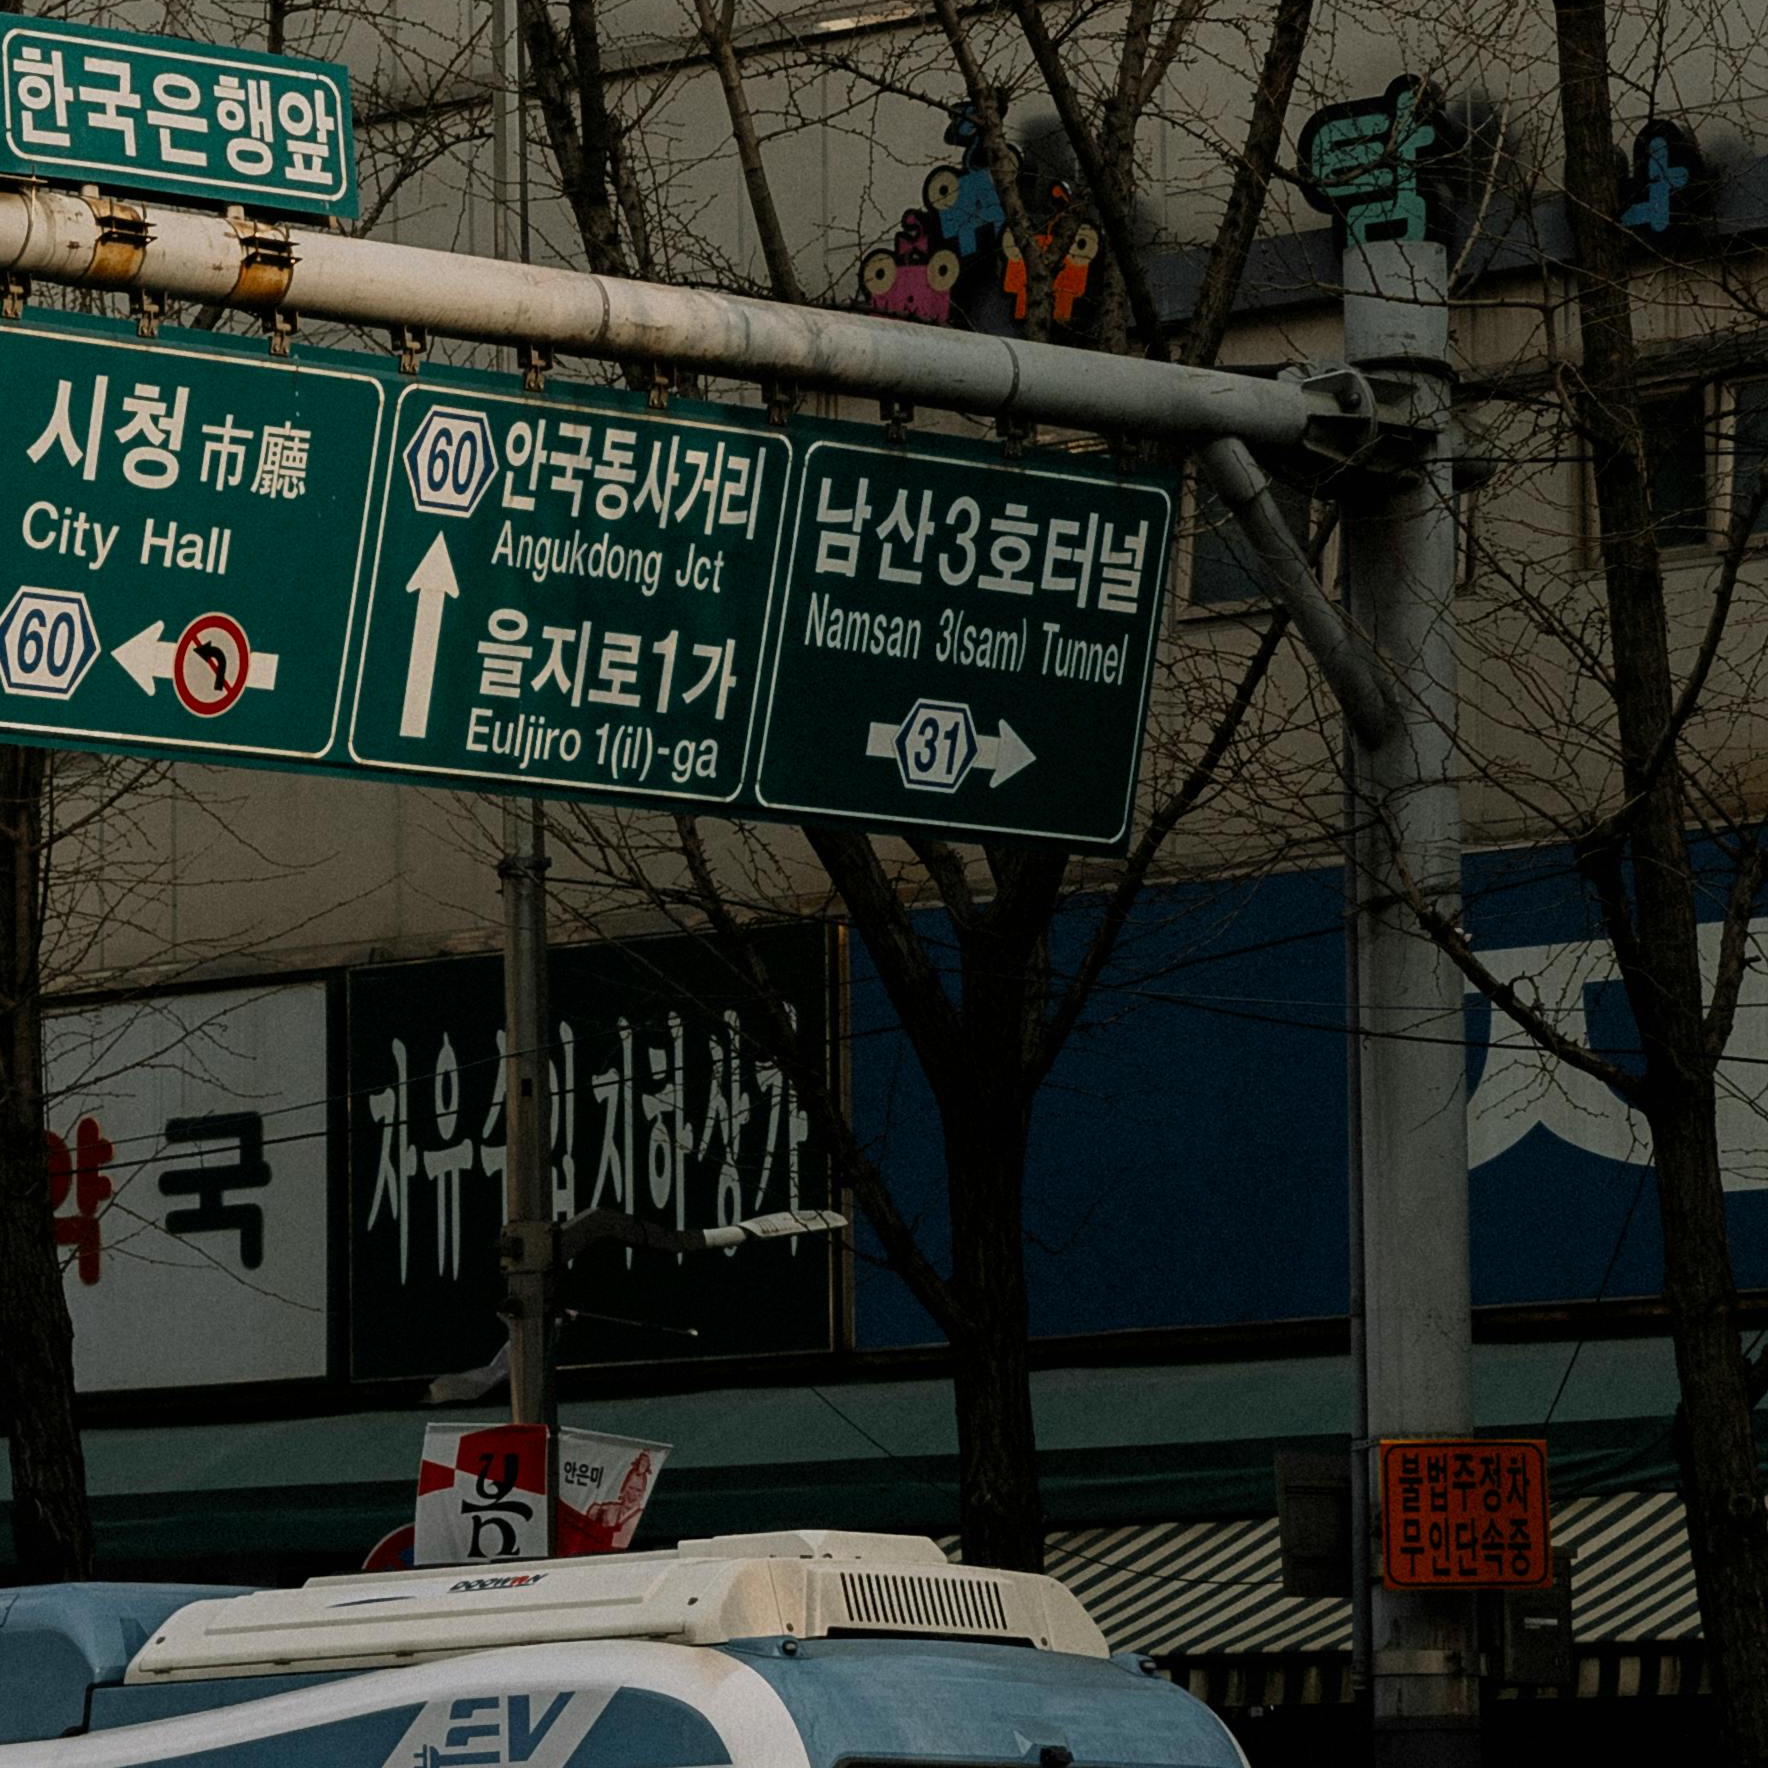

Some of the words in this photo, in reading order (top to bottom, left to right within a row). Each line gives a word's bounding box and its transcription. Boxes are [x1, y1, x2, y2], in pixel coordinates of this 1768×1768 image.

[12, 45, 335, 186] 한국은행앞
[26, 374, 190, 490] 시청
[199, 413, 312, 500] 市廳
[431, 427, 478, 496] 60
[501, 418, 767, 541] 안국동사거리
[22, 500, 120, 570] City
[140, 518, 231, 575] Hall
[490, 519, 663, 598] Angukdong
[674, 542, 725, 594] Jct
[814, 476, 1150, 615] 남산3호터널
[17, 608, 75, 677] 60
[476, 607, 737, 721] 을지로1가
[803, 591, 922, 660] Namsan
[935, 607, 1027, 673] 3(sam)
[1040, 621, 1129, 686] Tunnel
[465, 706, 582, 770] Euljiro
[595, 721, 719, 784] 1(il)-ga
[913, 716, 960, 775] 31
[563, 1461, 605, 1489] 안은미
[1399, 1453, 1530, 1513] 불법주정차
[1400, 1517, 1532, 1577] 무인단속중
[437, 1691, 576, 1766] EV
